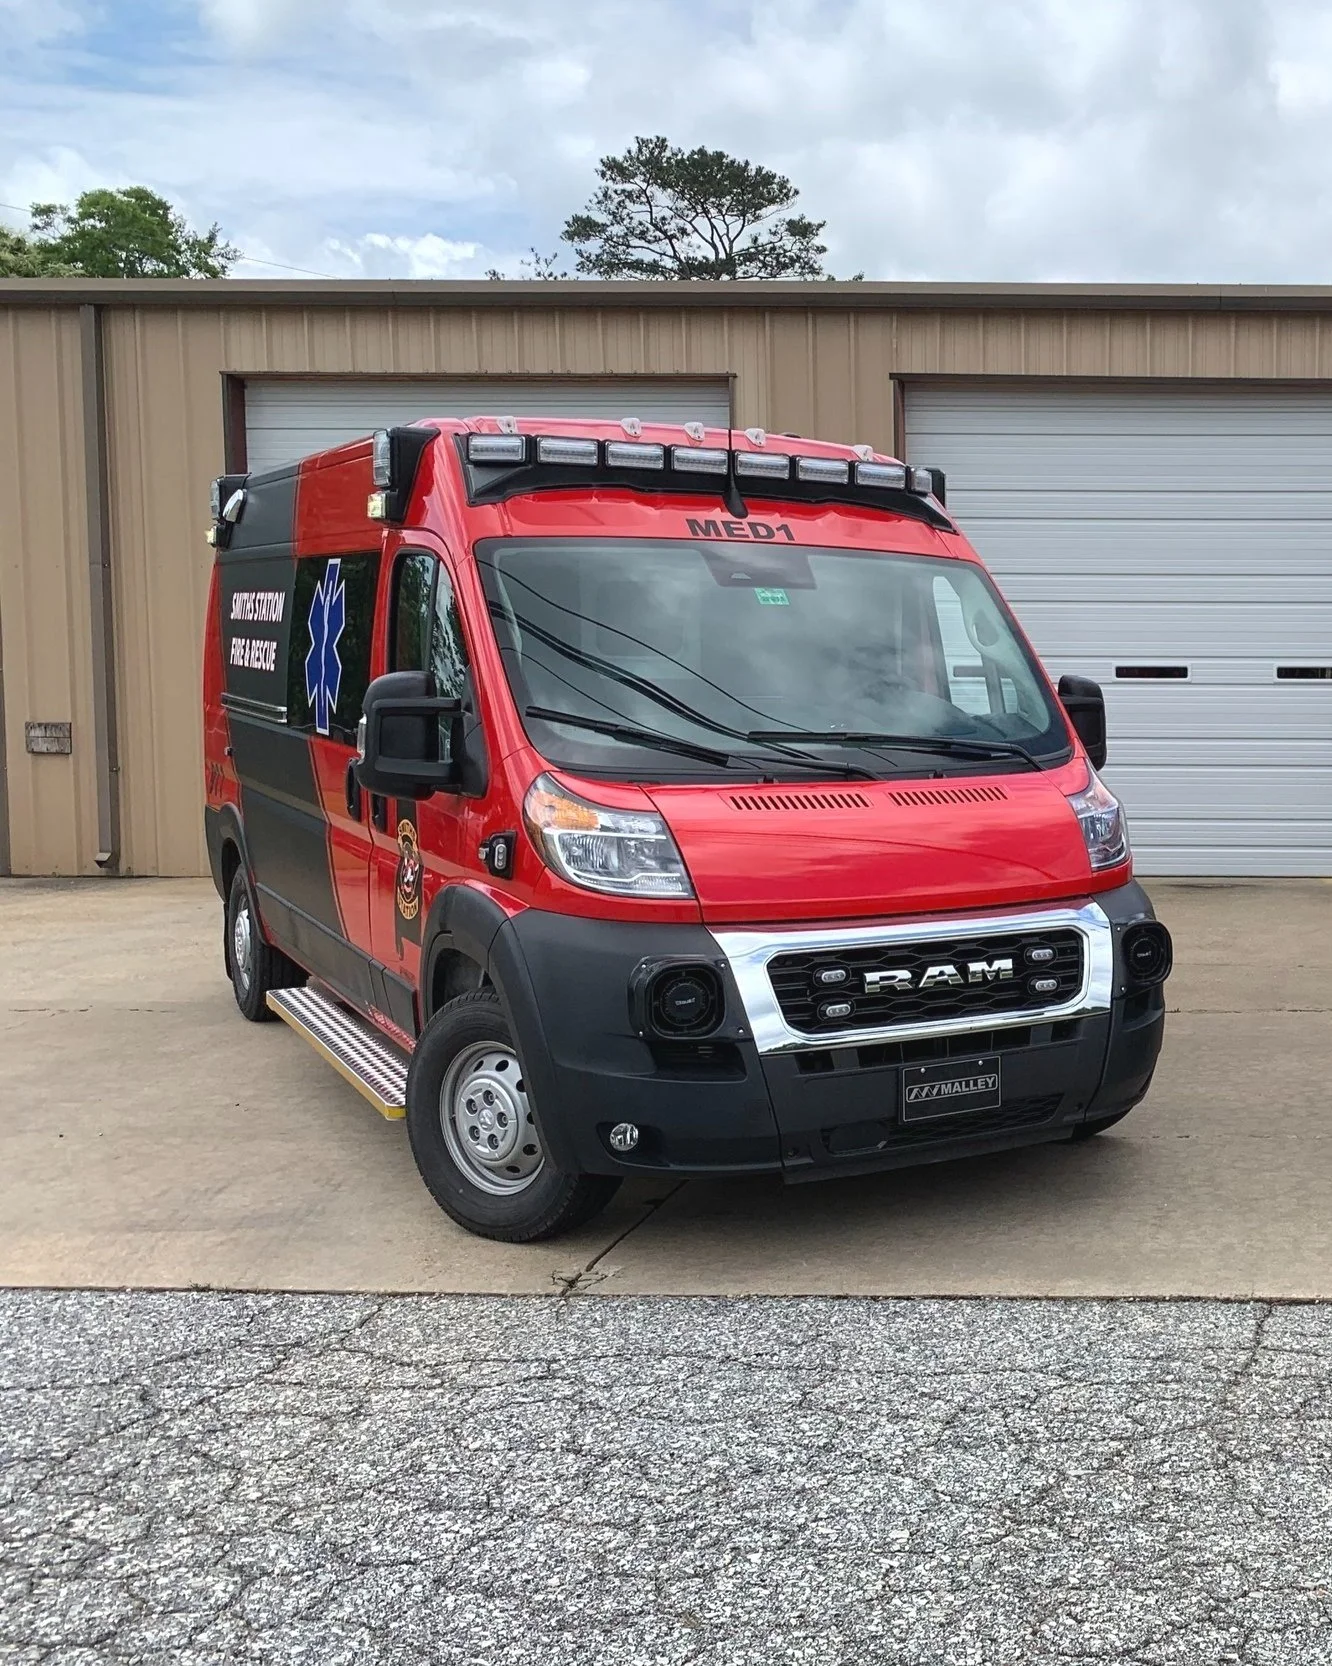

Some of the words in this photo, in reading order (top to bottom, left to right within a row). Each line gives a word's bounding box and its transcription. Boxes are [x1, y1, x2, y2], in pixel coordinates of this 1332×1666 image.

[686, 518, 795, 541] MED1
[230, 592, 256, 620] SMITHS
[254, 591, 286, 622] STATION
[230, 637, 246, 667] FIRE
[249, 639, 277, 672] RESCUE
[863, 958, 1014, 994] RAM
[941, 1076, 996, 1096] MALLEY
